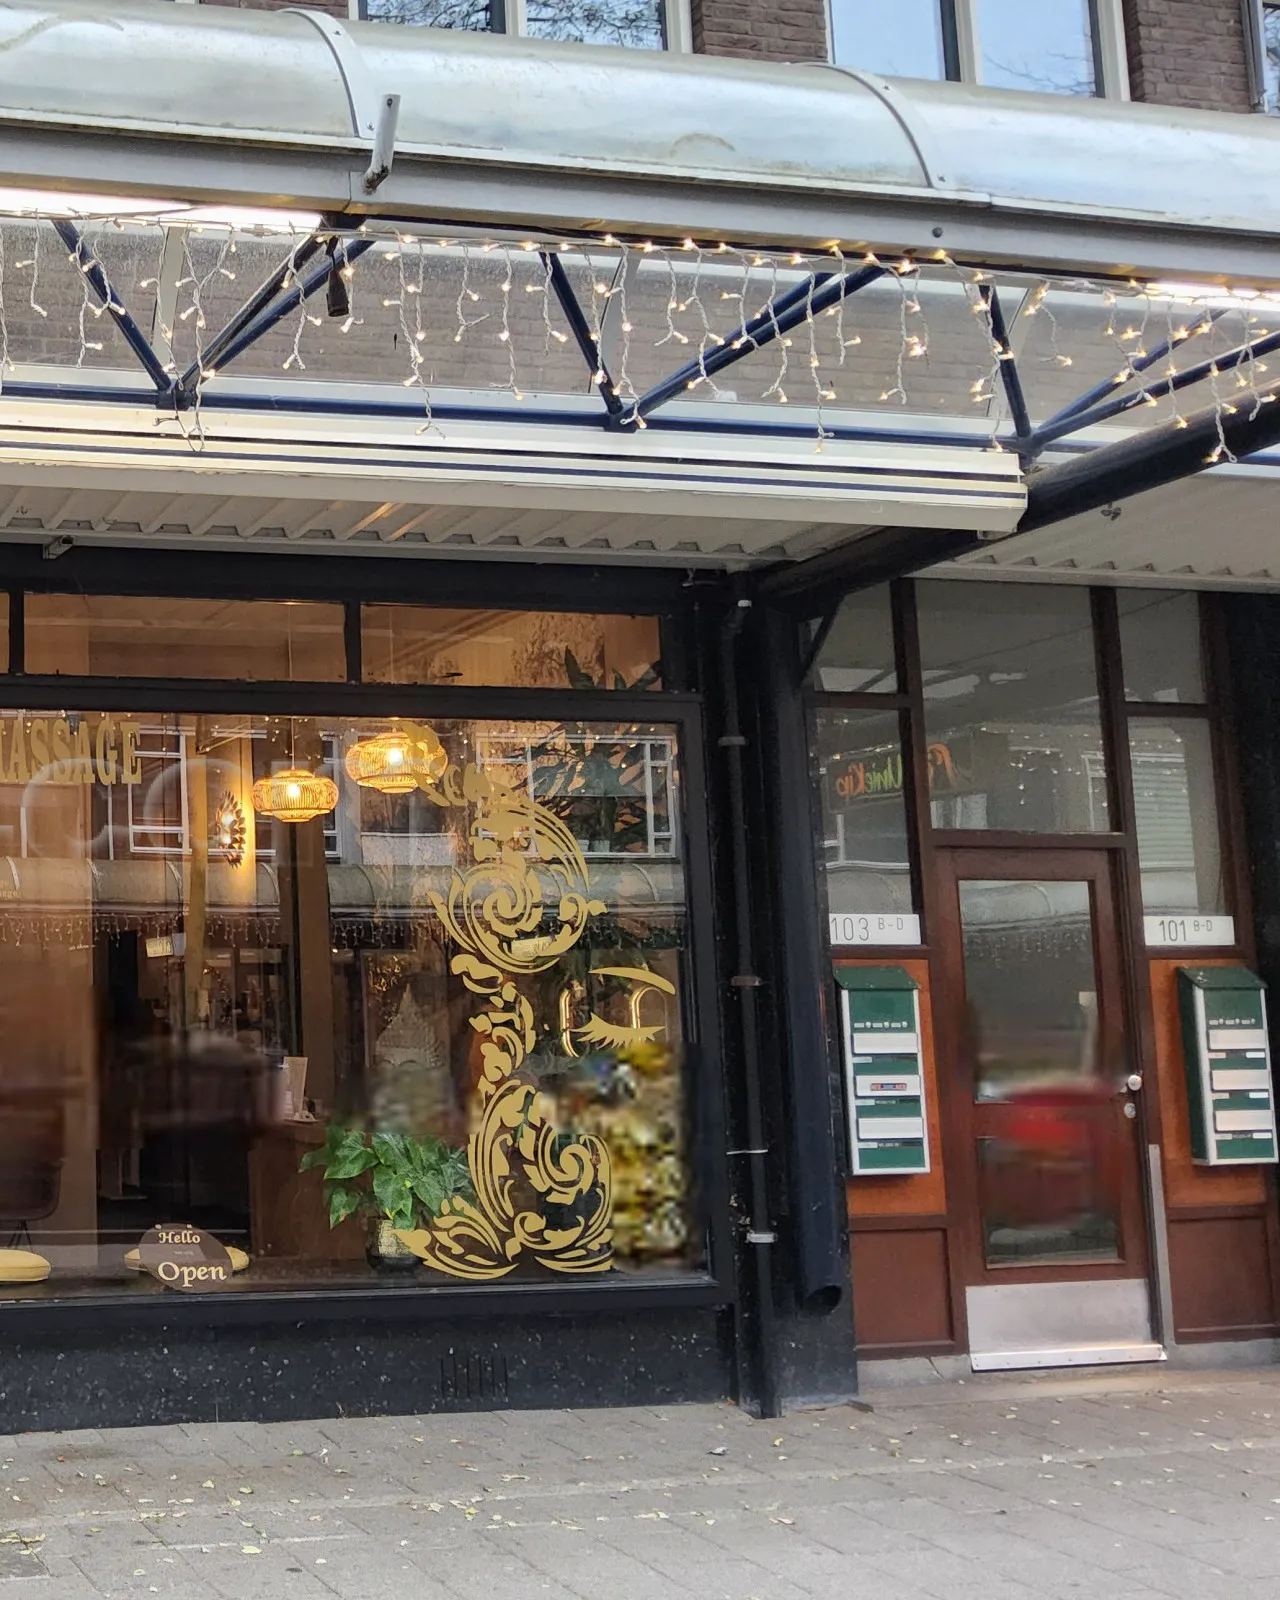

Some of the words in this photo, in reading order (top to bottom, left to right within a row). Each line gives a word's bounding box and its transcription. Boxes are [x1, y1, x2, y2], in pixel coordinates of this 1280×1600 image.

[830, 917, 869, 941] 103
[877, 917, 905, 931] B-D
[1158, 919, 1188, 942] 101
[158, 1230, 201, 1244] Hello
[157, 1261, 228, 1288] Open
